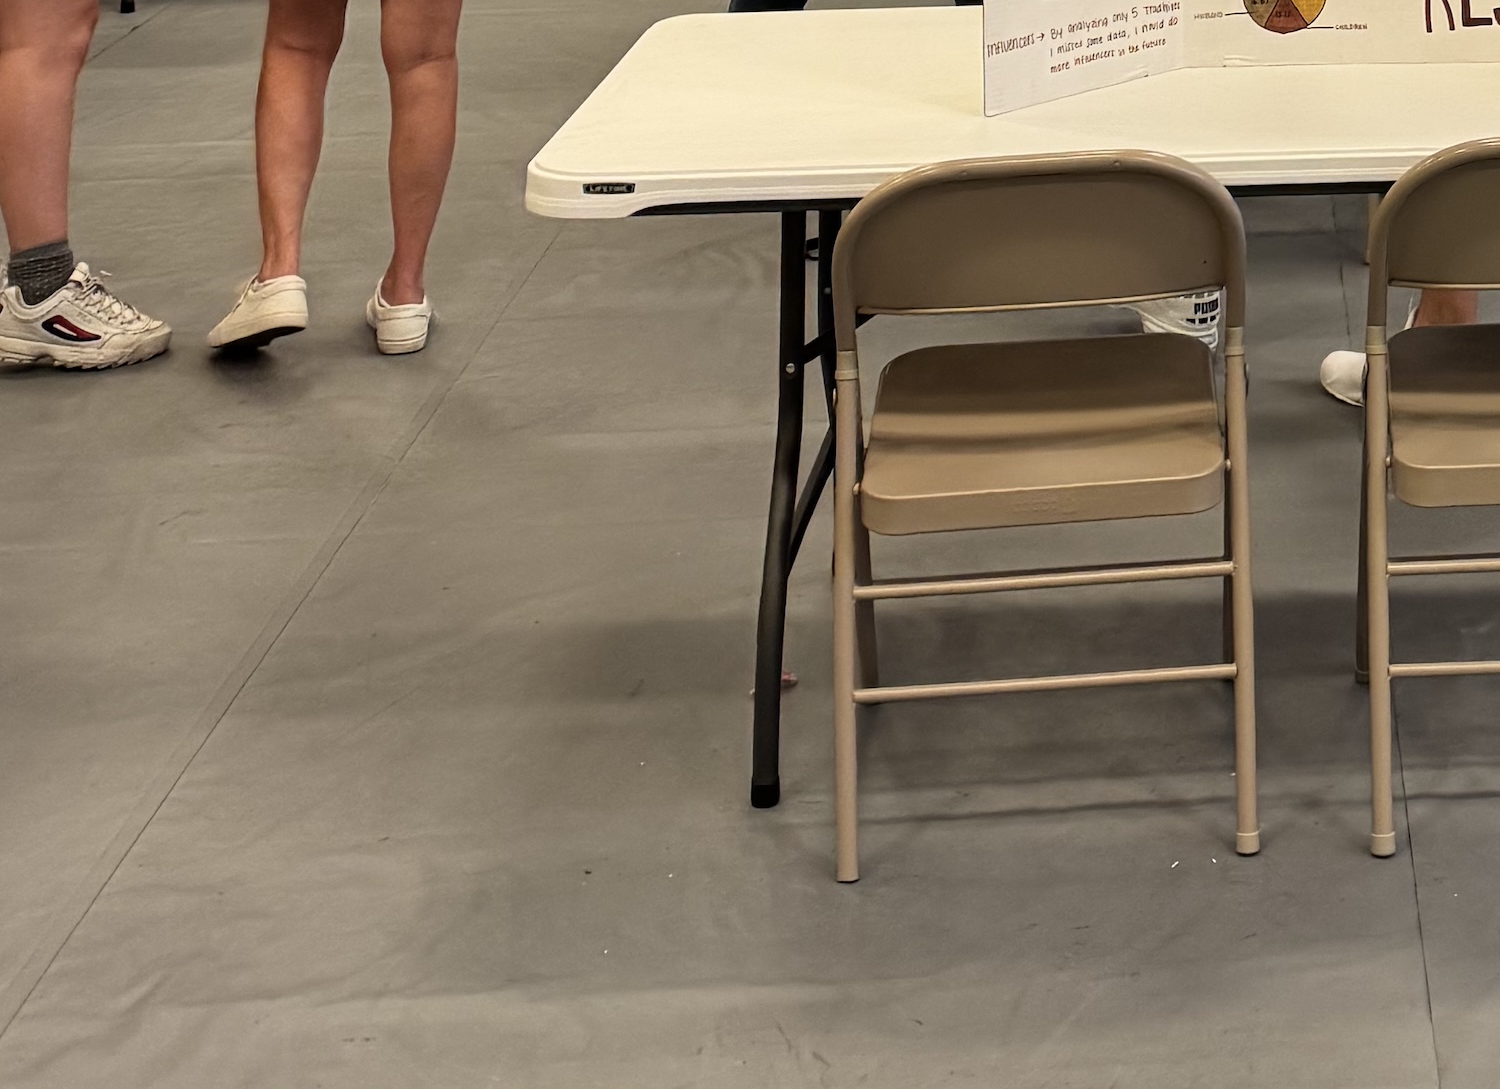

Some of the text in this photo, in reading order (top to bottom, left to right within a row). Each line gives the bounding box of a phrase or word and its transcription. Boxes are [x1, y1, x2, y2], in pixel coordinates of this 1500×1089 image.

[1051, 7, 1138, 40] By analyzing only 5
[987, 34, 1034, 58] Influencers
[1058, 41, 1082, 54] missed
[1074, 38, 1166, 66] influencers future
